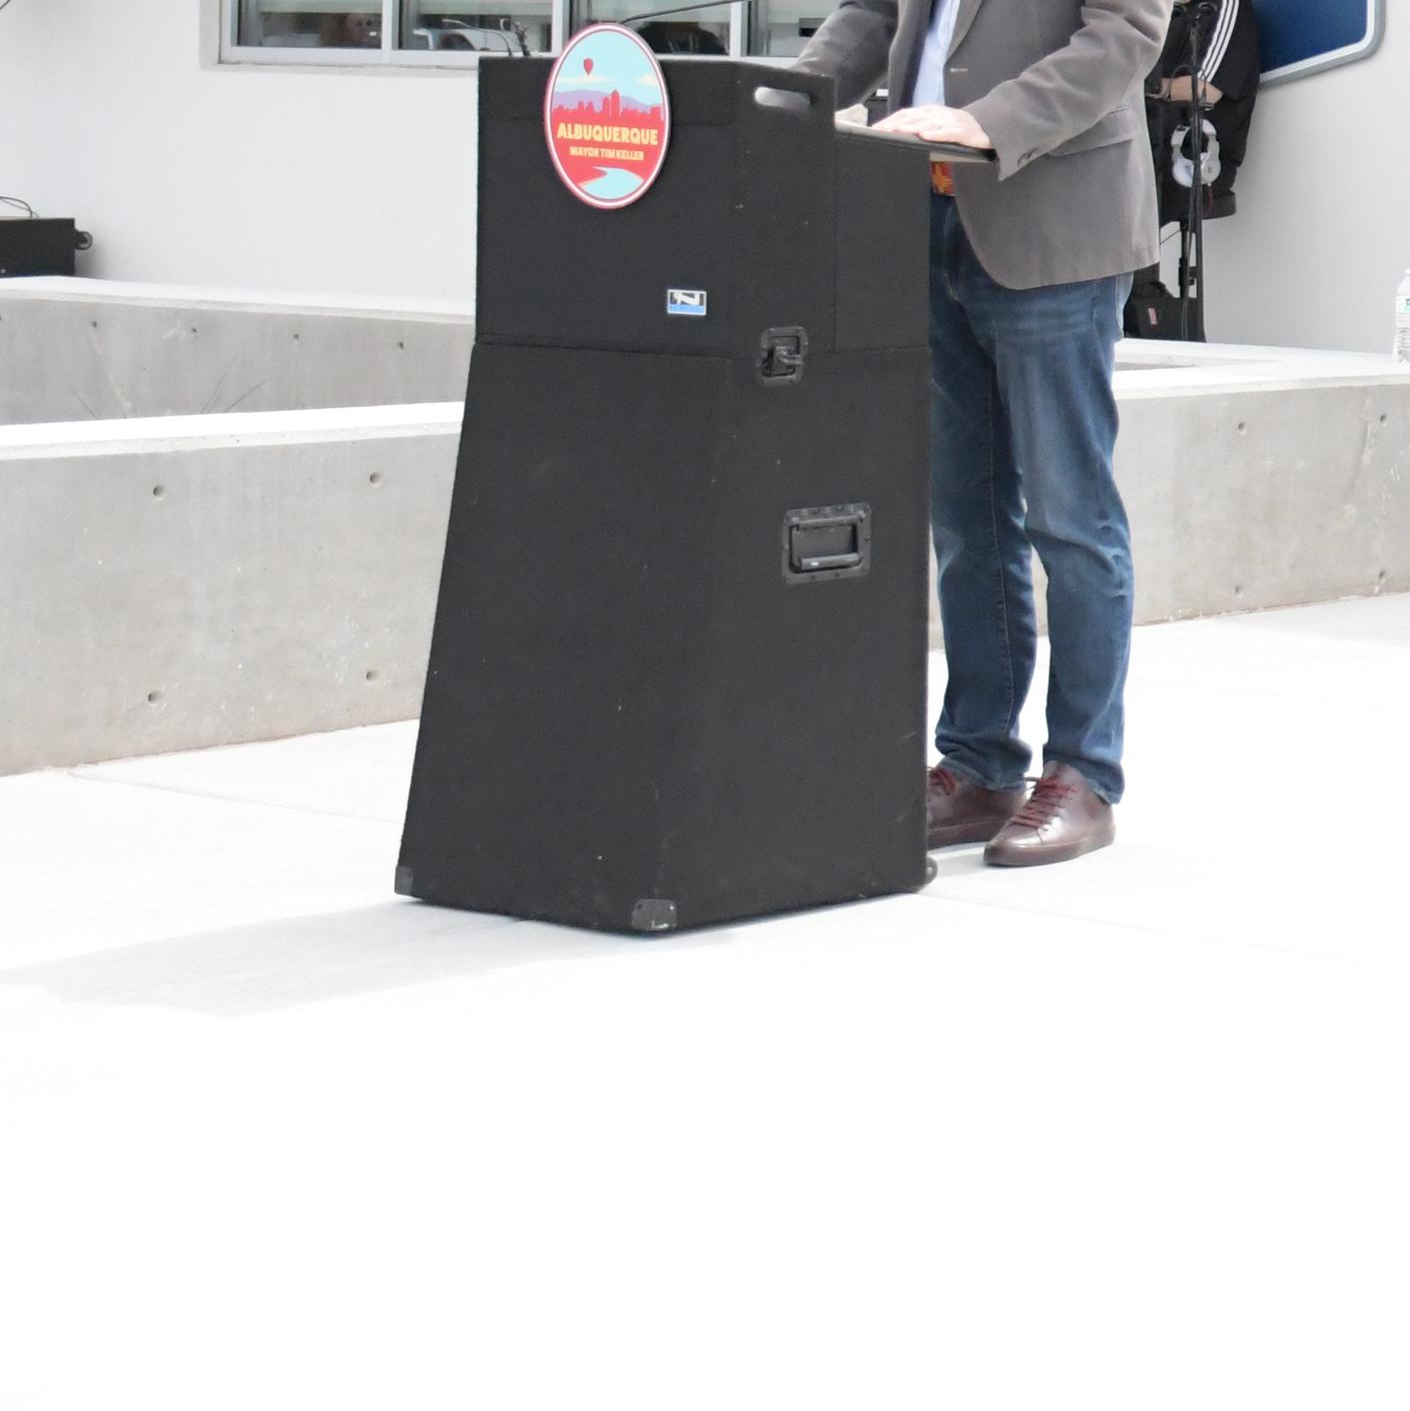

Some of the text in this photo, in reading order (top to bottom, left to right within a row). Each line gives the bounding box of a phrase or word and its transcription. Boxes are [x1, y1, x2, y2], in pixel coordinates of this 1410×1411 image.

[557, 122, 659, 145] ALBUQUERQUE
[569, 146, 644, 161] MAYOR TIM KELLER
